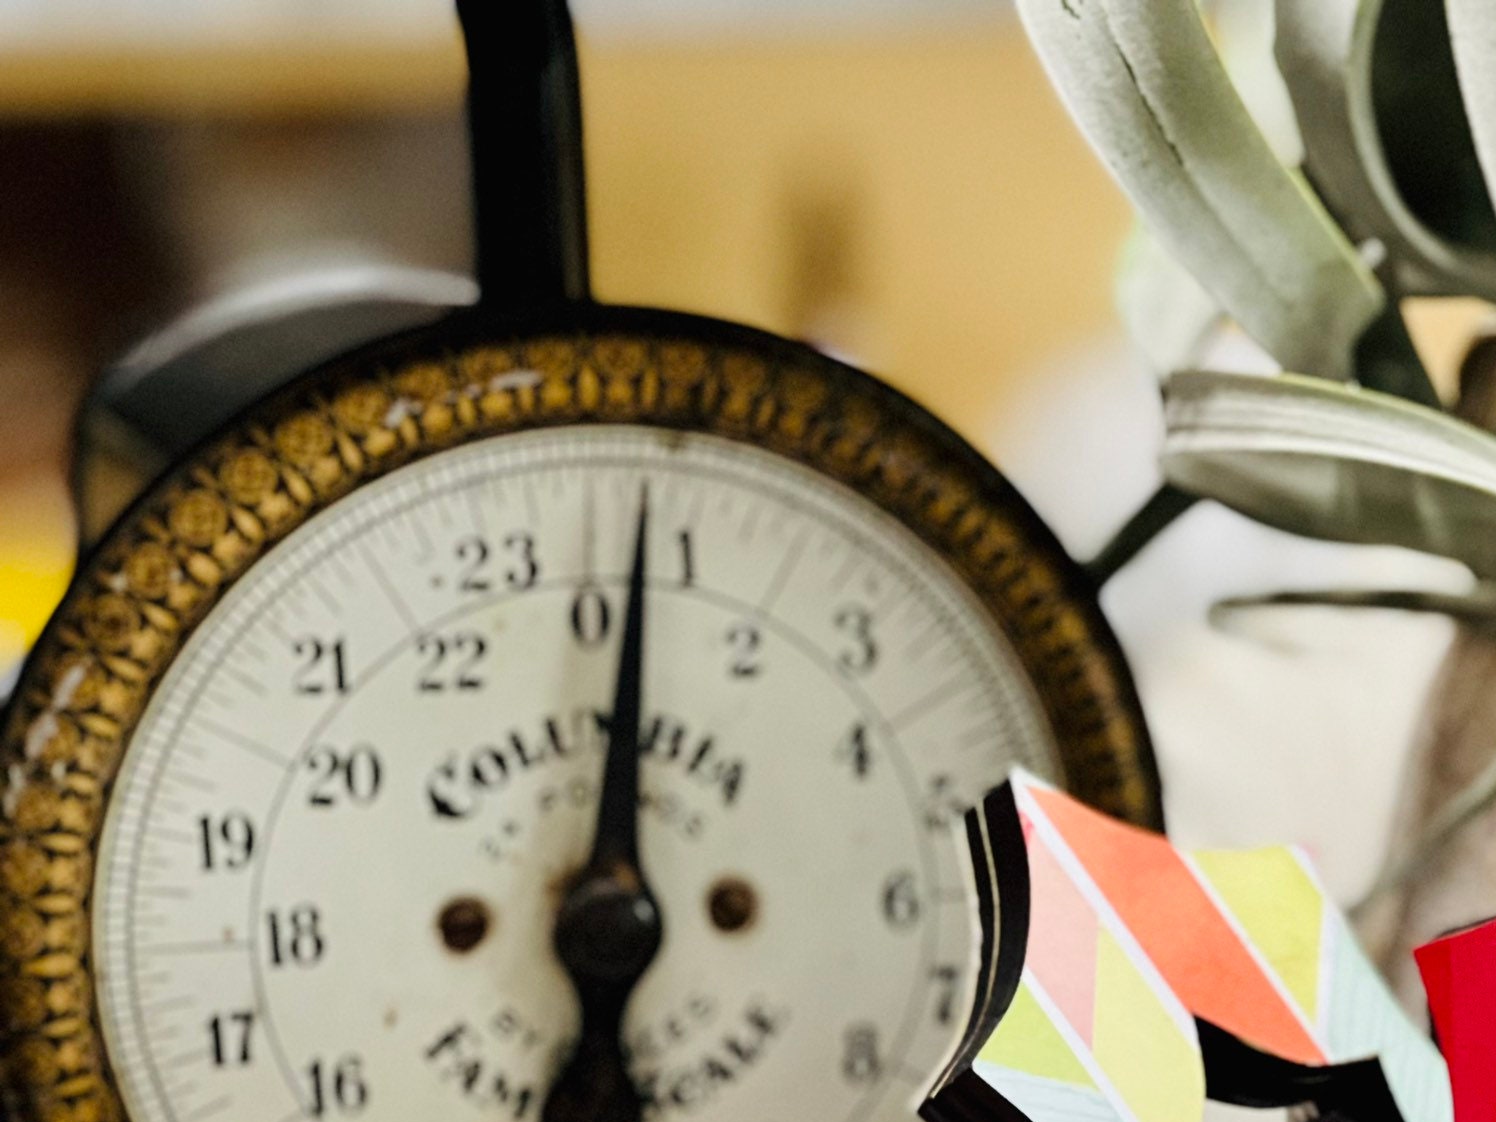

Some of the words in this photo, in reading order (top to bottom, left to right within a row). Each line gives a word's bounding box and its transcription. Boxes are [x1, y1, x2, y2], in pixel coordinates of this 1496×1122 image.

[455, 533, 540, 593] 23
[677, 529, 696, 589] 1
[569, 588, 611, 652] 0
[832, 605, 879, 673] 3
[295, 636, 350, 696] 21
[416, 633, 489, 691] 22
[725, 622, 762, 681] 2
[306, 746, 382, 807] 20
[834, 721, 871, 783] 4
[200, 813, 255, 870] 19
[881, 868, 920, 930] 6
[265, 905, 326, 970] 18
[929, 962, 957, 1028] 7
[207, 1012, 256, 1068] 17
[841, 1020, 883, 1087] 8
[306, 1056, 370, 1120] 16
